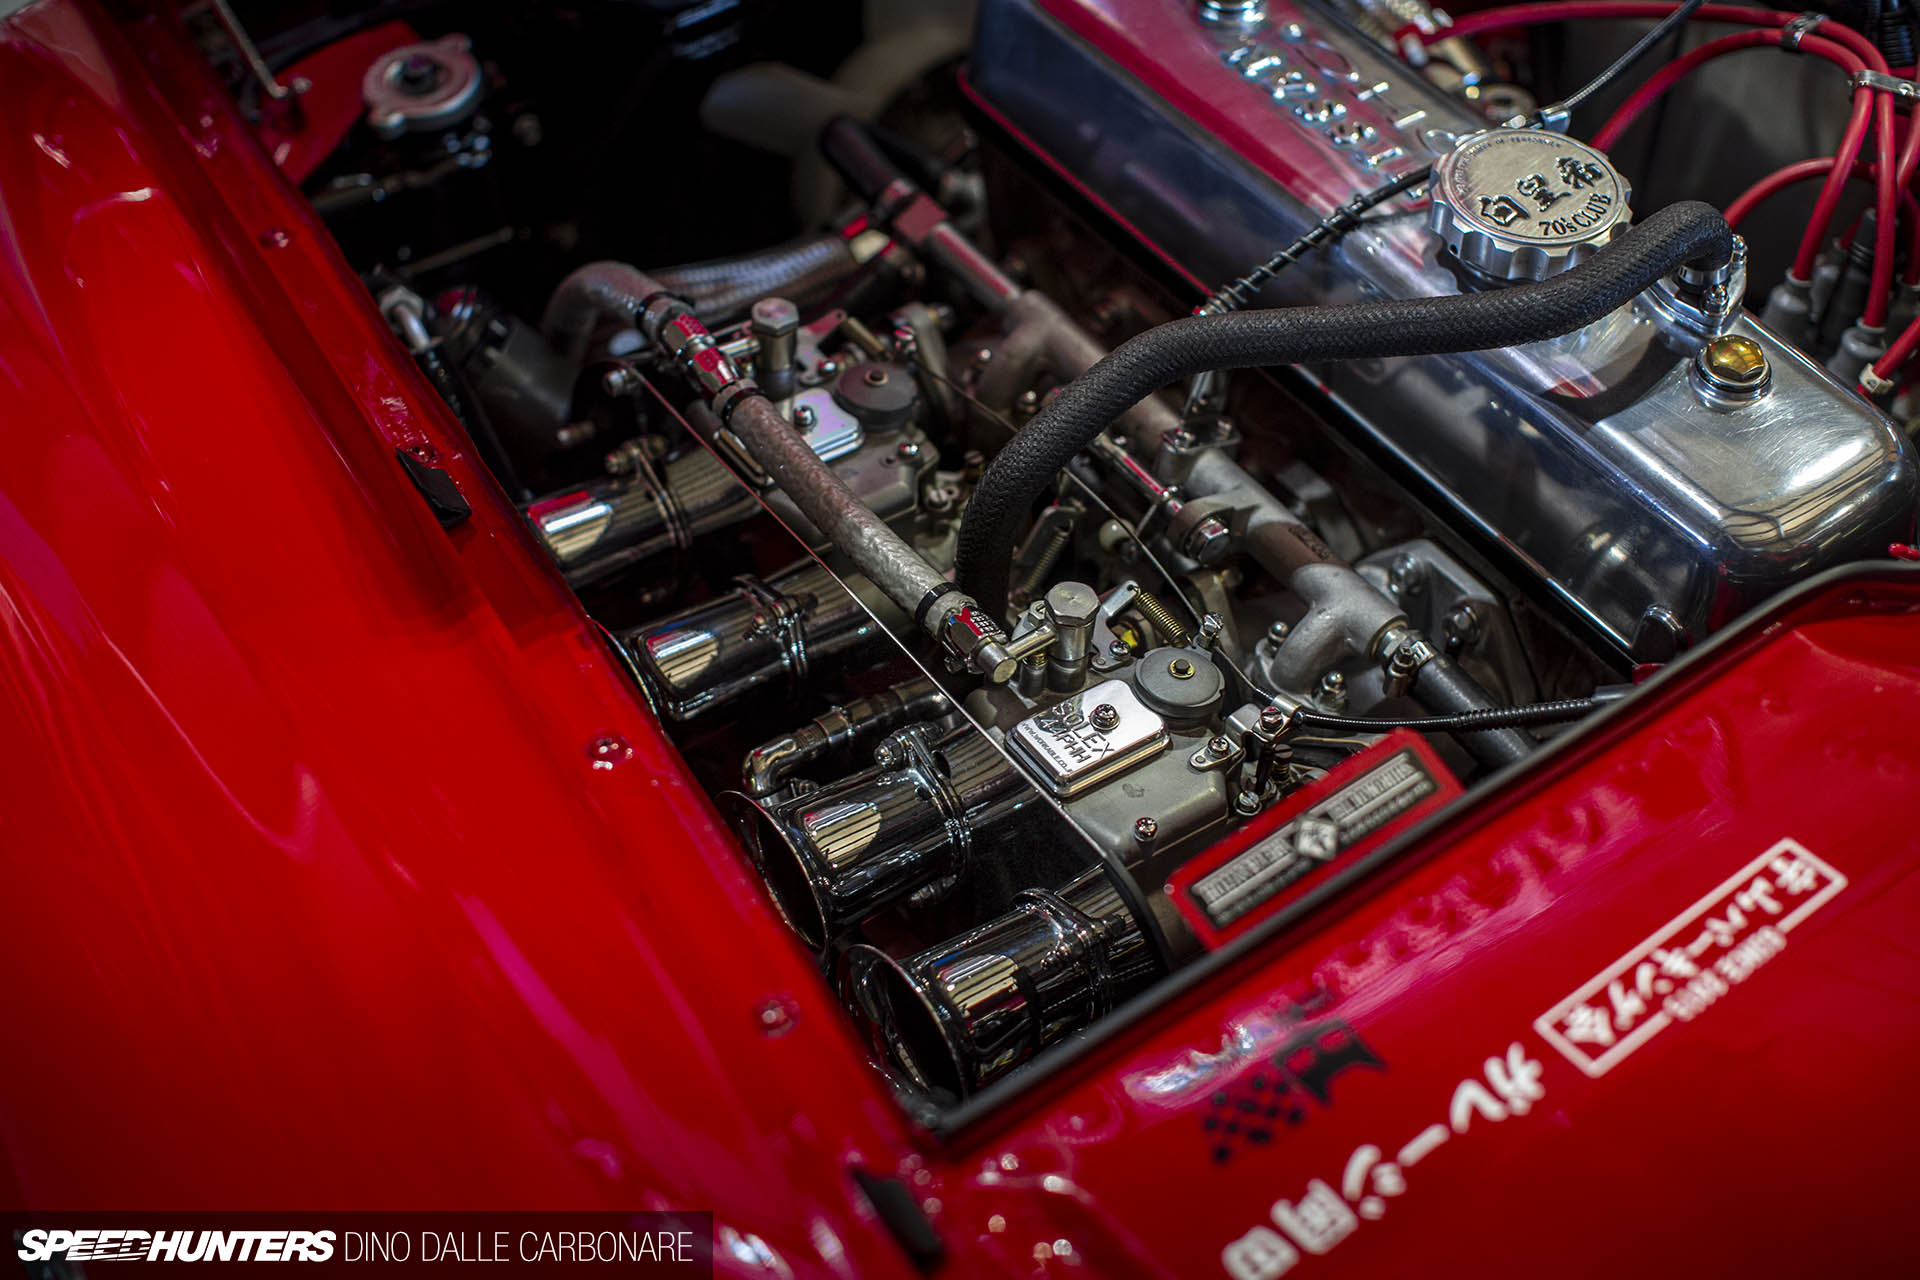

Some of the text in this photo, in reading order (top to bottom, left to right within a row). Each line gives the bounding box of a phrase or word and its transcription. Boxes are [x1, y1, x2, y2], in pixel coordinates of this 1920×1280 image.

[1538, 193, 1611, 236] 70's CLUB
[1040, 718, 1092, 764] 44PHH
[1051, 701, 1115, 760] SOLEX
